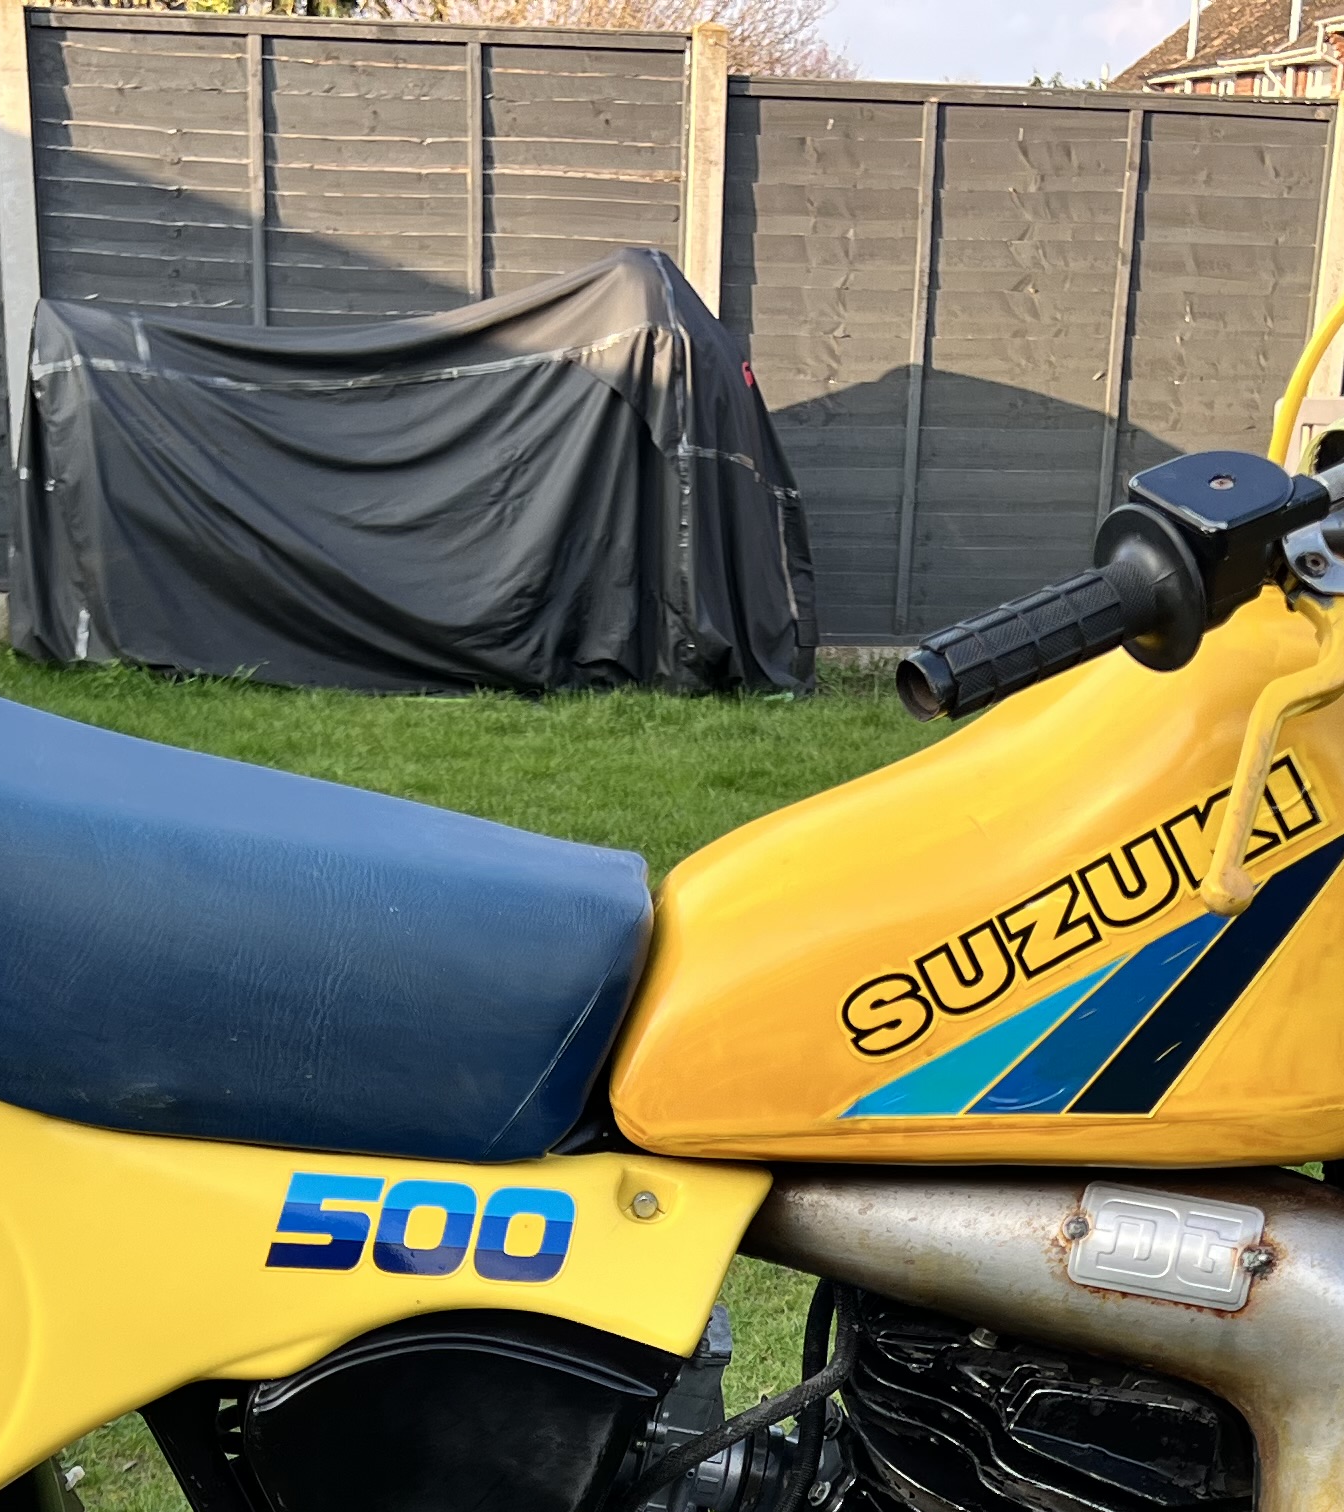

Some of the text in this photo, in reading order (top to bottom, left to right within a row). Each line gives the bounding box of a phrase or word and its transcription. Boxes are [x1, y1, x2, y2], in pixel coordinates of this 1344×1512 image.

[841, 755, 1323, 1056] SUZUKI
[265, 1172, 575, 1282] 500
[1095, 1198, 1244, 1293] DG
